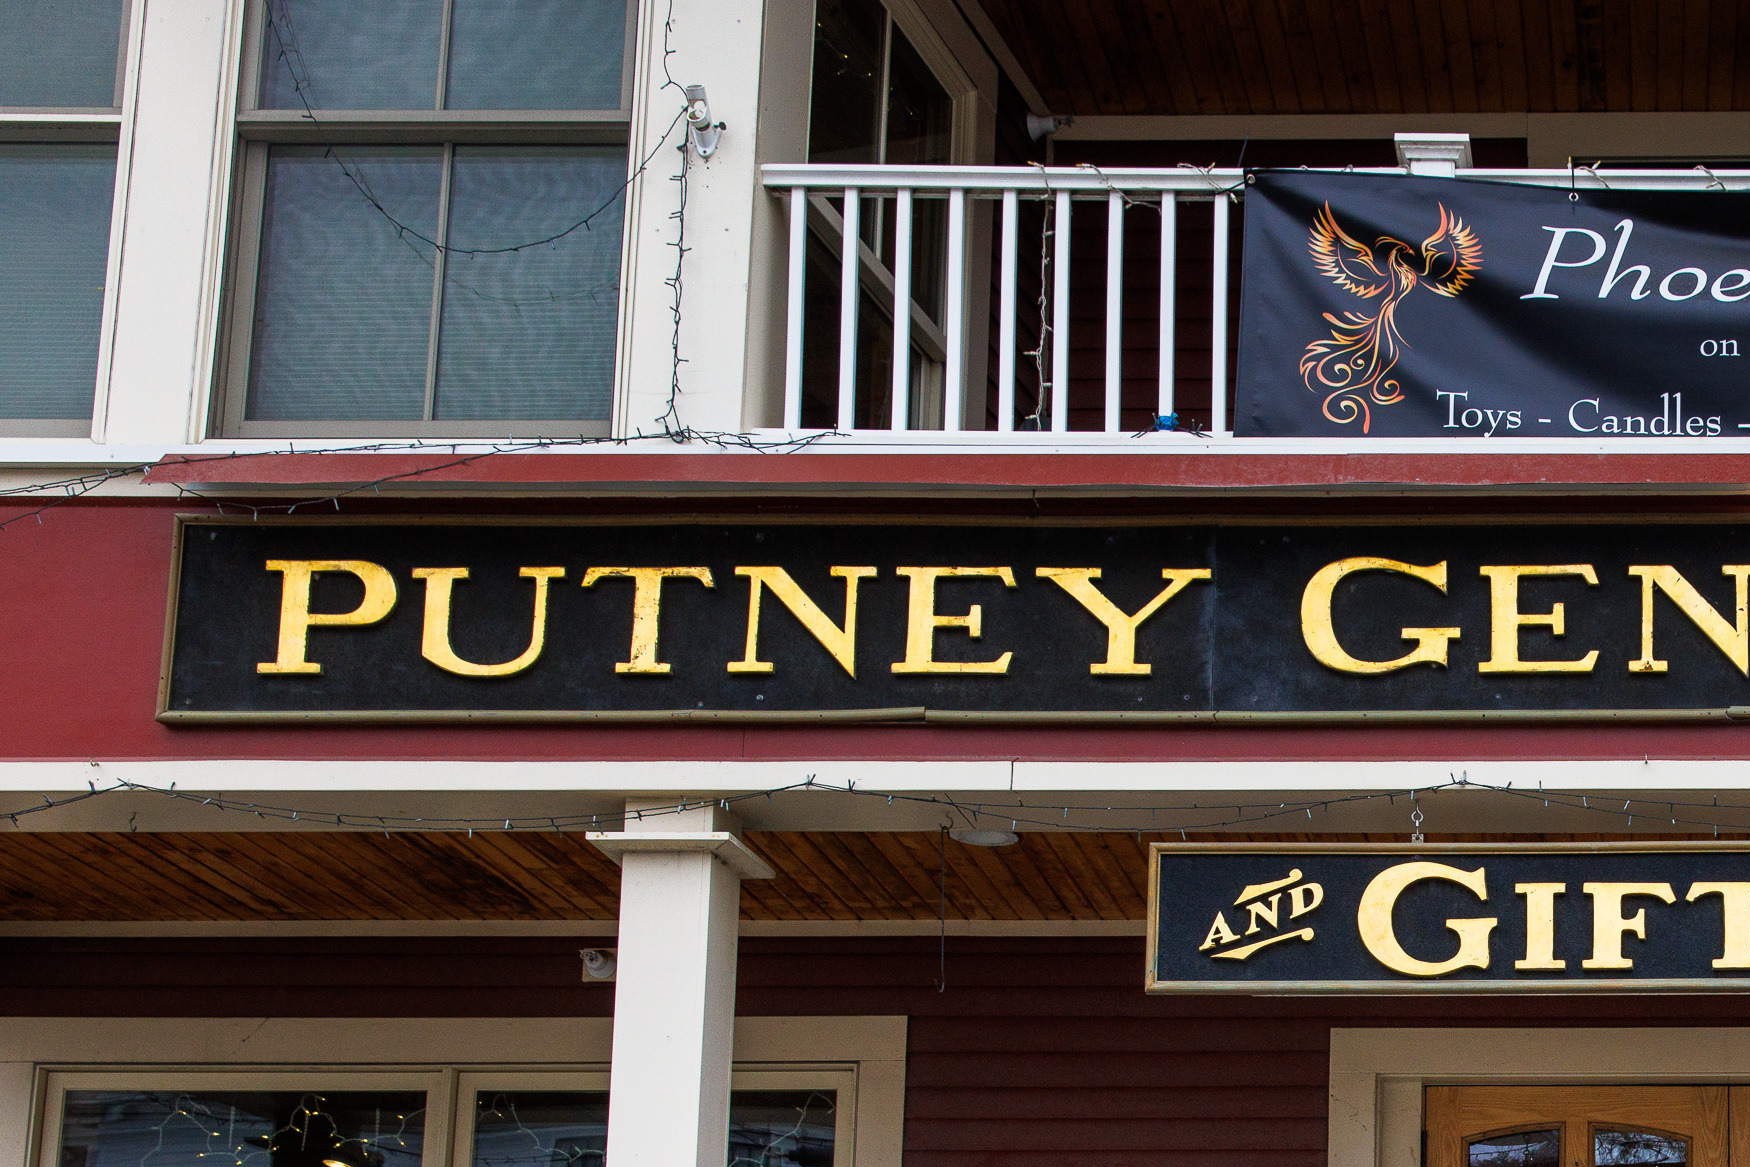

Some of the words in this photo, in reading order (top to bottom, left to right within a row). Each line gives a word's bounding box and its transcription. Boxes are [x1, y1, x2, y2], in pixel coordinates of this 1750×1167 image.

[1699, 336, 1739, 360] on
[1437, 390, 1522, 438] Toys
[1567, 393, 1721, 437] Candles
[256, 559, 1211, 678] PUTNEY
[1200, 880, 1325, 950] AND
